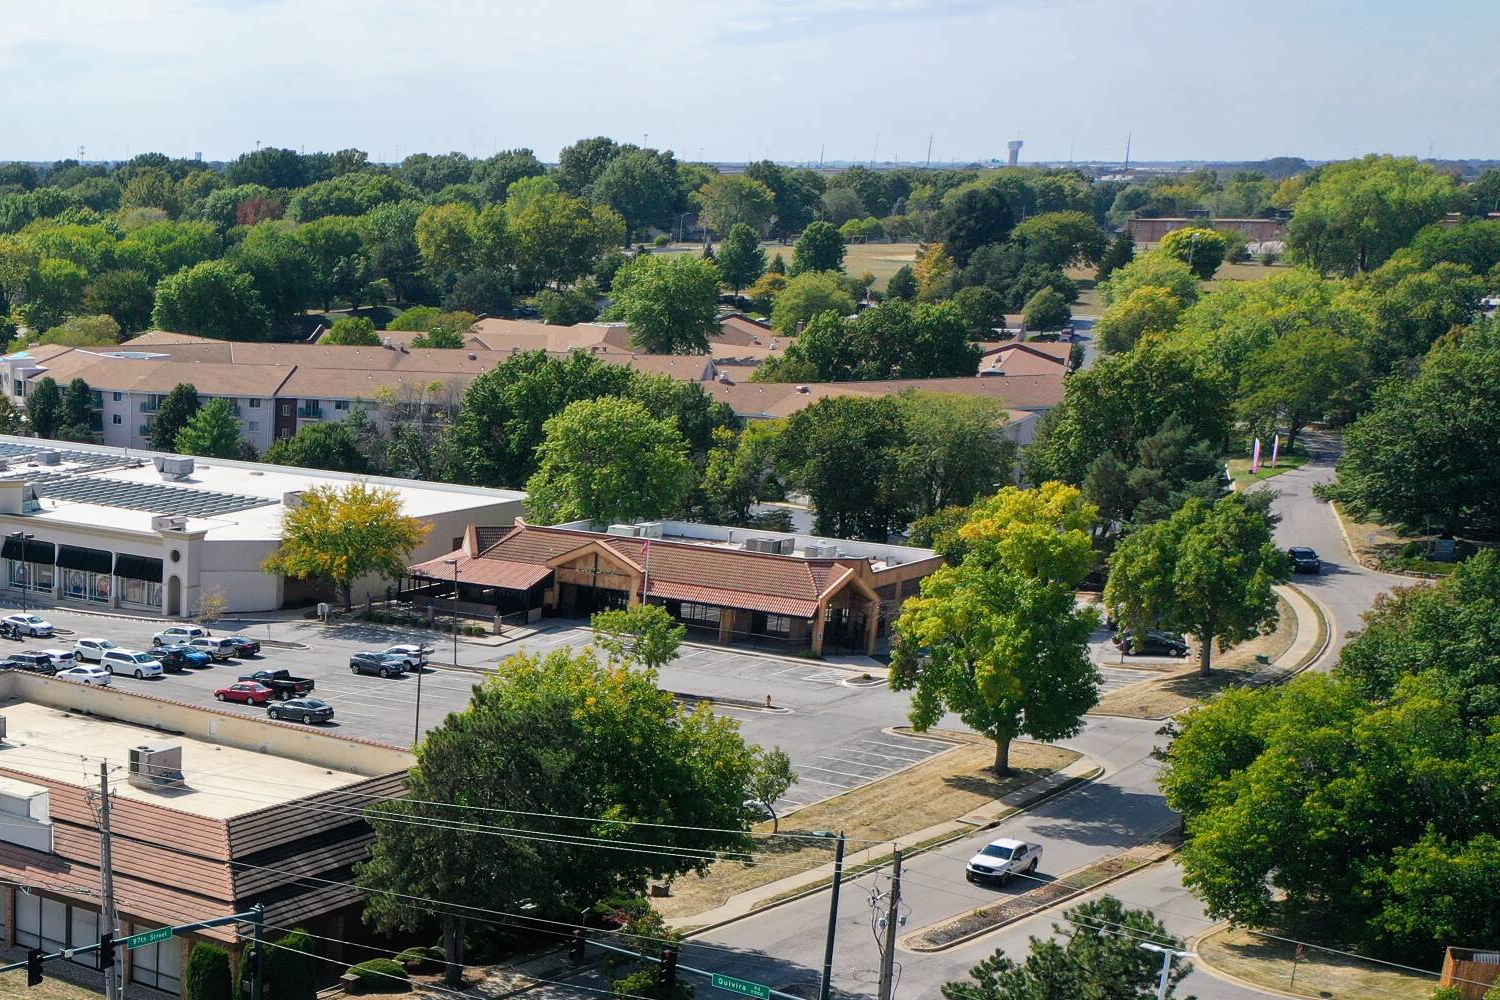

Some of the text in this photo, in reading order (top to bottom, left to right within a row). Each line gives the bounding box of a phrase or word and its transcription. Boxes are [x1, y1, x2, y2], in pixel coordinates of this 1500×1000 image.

[132, 930, 168, 945] 97th Street
[718, 977, 747, 991] Quivira
